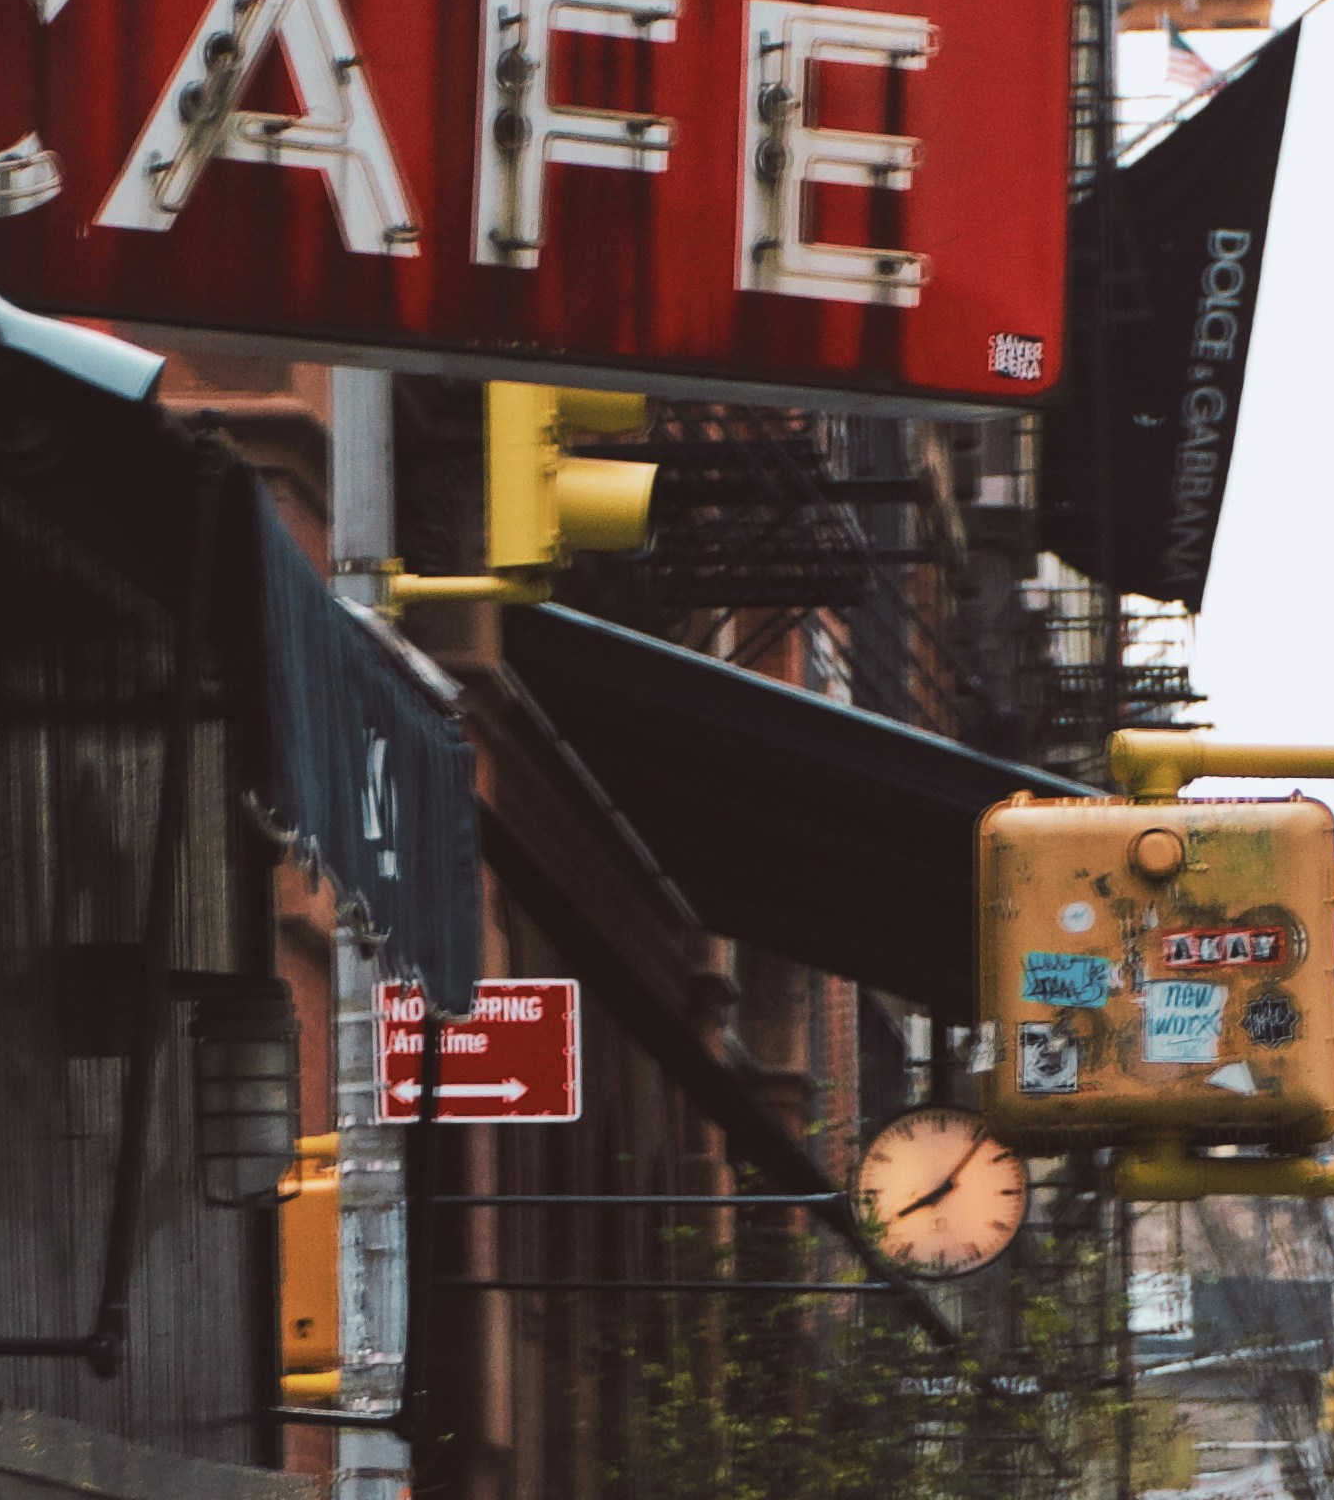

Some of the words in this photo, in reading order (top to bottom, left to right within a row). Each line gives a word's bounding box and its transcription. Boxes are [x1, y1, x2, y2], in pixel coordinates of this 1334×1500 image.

[1189, 229, 1252, 361] DOLCE
[1163, 386, 1227, 583] GABBANA
[385, 996, 425, 1022] NO
[388, 1027, 490, 1055] Antime
